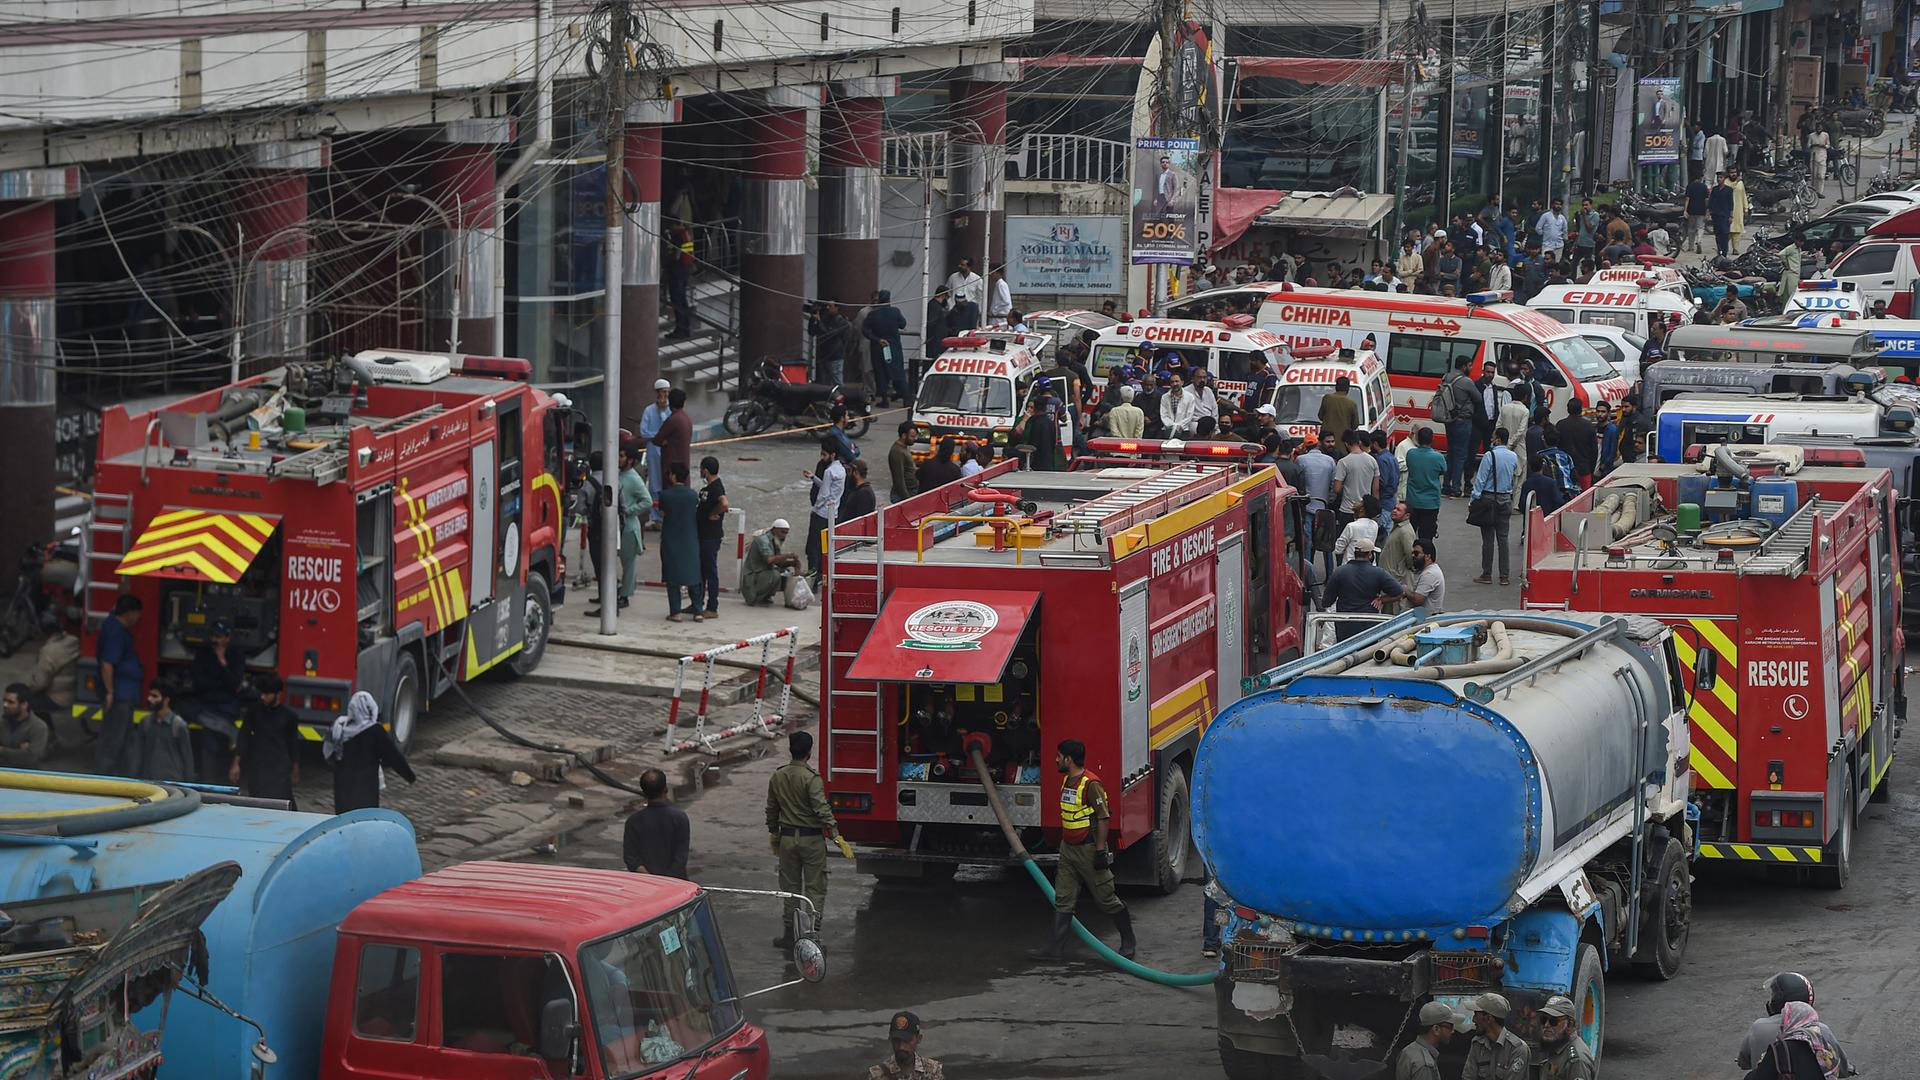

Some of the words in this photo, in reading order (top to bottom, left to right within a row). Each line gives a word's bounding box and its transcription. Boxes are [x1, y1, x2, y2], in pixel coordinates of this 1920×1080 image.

[1167, 141, 1196, 149] POINT
[1645, 135, 1673, 147] 50%
[1060, 226, 1070, 239] RJ
[1142, 223, 1185, 239] 50%
[1021, 244, 1070, 255] MOBILE
[1075, 244, 1111, 256] MALL
[1600, 271, 1647, 281] CHHIPA
[1562, 291, 1637, 306] EDHI
[1801, 297, 1850, 309] JDC
[1281, 305, 1351, 326] CHHIPA
[1145, 326, 1214, 344] CHHIPA
[934, 358, 1008, 376] CHHIPA
[1286, 368, 1359, 384] CHHIPA
[936, 415, 989, 427] CHHIPA
[1151, 546, 1171, 579] FIRE
[1173, 542, 1180, 568] &
[1182, 525, 1215, 564] RESCUE
[288, 556, 342, 582] RESCUE
[1630, 588, 1714, 599] CARMICHAEL
[1749, 661, 1809, 687] RESCUE
